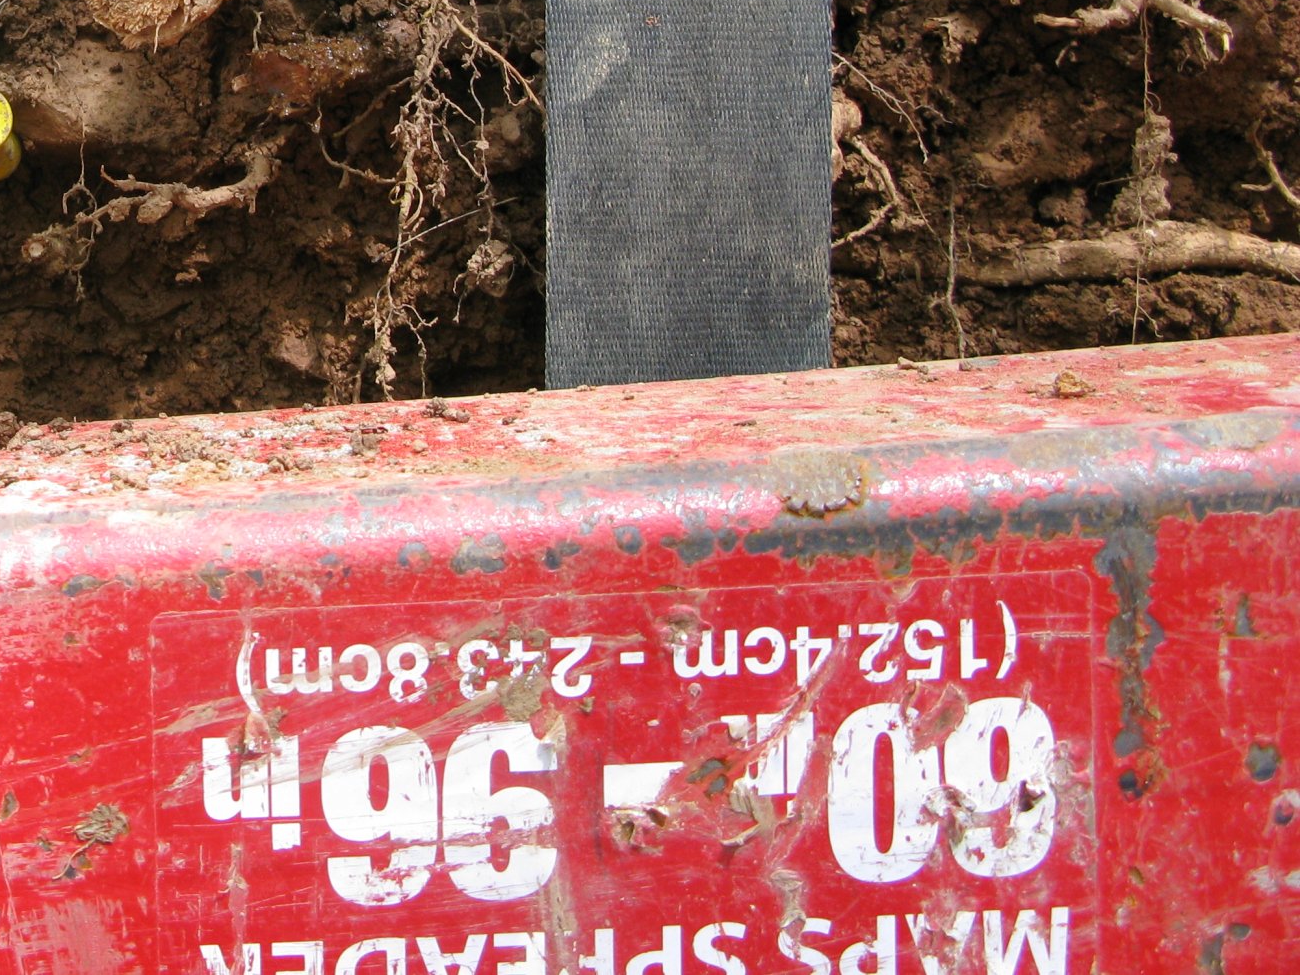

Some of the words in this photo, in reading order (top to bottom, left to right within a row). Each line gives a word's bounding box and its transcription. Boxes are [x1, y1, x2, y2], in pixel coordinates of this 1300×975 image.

[234, 631, 592, 713] 243.8cm)
[672, 599, 1017, 686] (152.4cm
[777, 905, 1069, 975] MAPS
